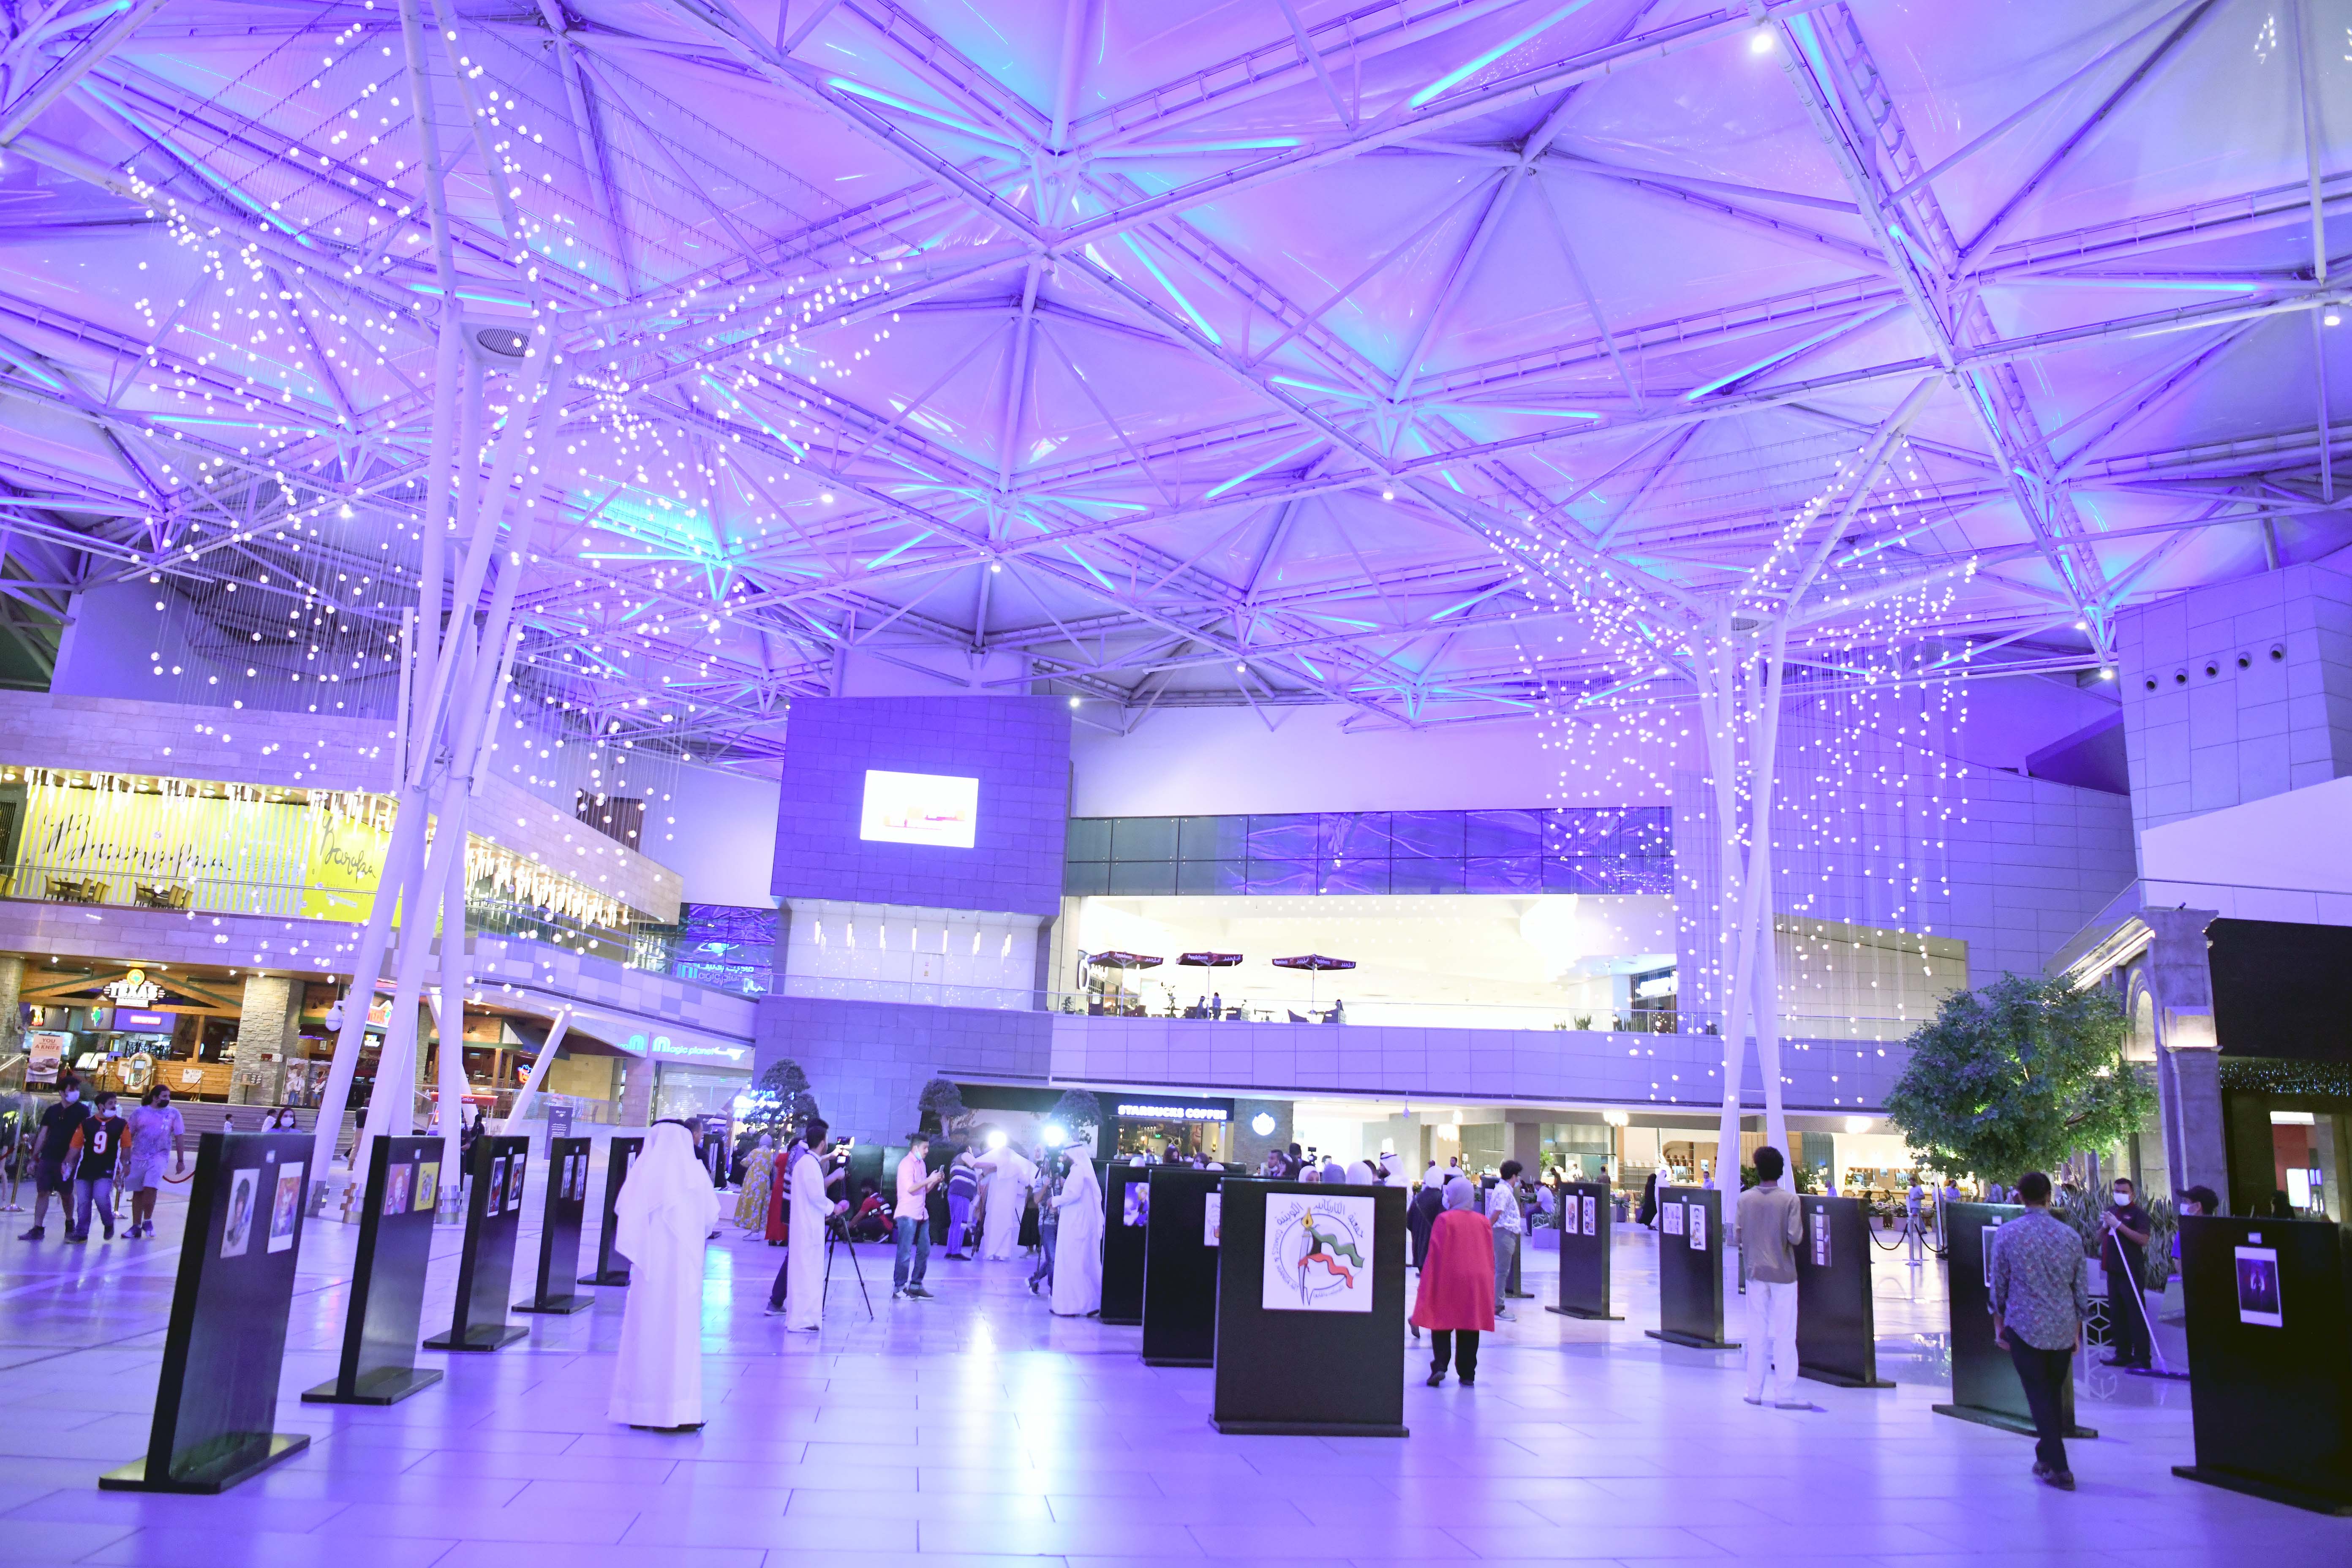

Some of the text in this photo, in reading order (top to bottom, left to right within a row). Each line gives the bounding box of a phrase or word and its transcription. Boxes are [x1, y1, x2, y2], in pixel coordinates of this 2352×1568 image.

[110, 982, 158, 999] TEXAS
[652, 1036, 688, 1055] Magic
[1118, 1105, 1227, 1120] STARBUCKS COFFEE
[93, 1131, 107, 1154] 9
[1271, 1229, 1283, 1255] COMICS
